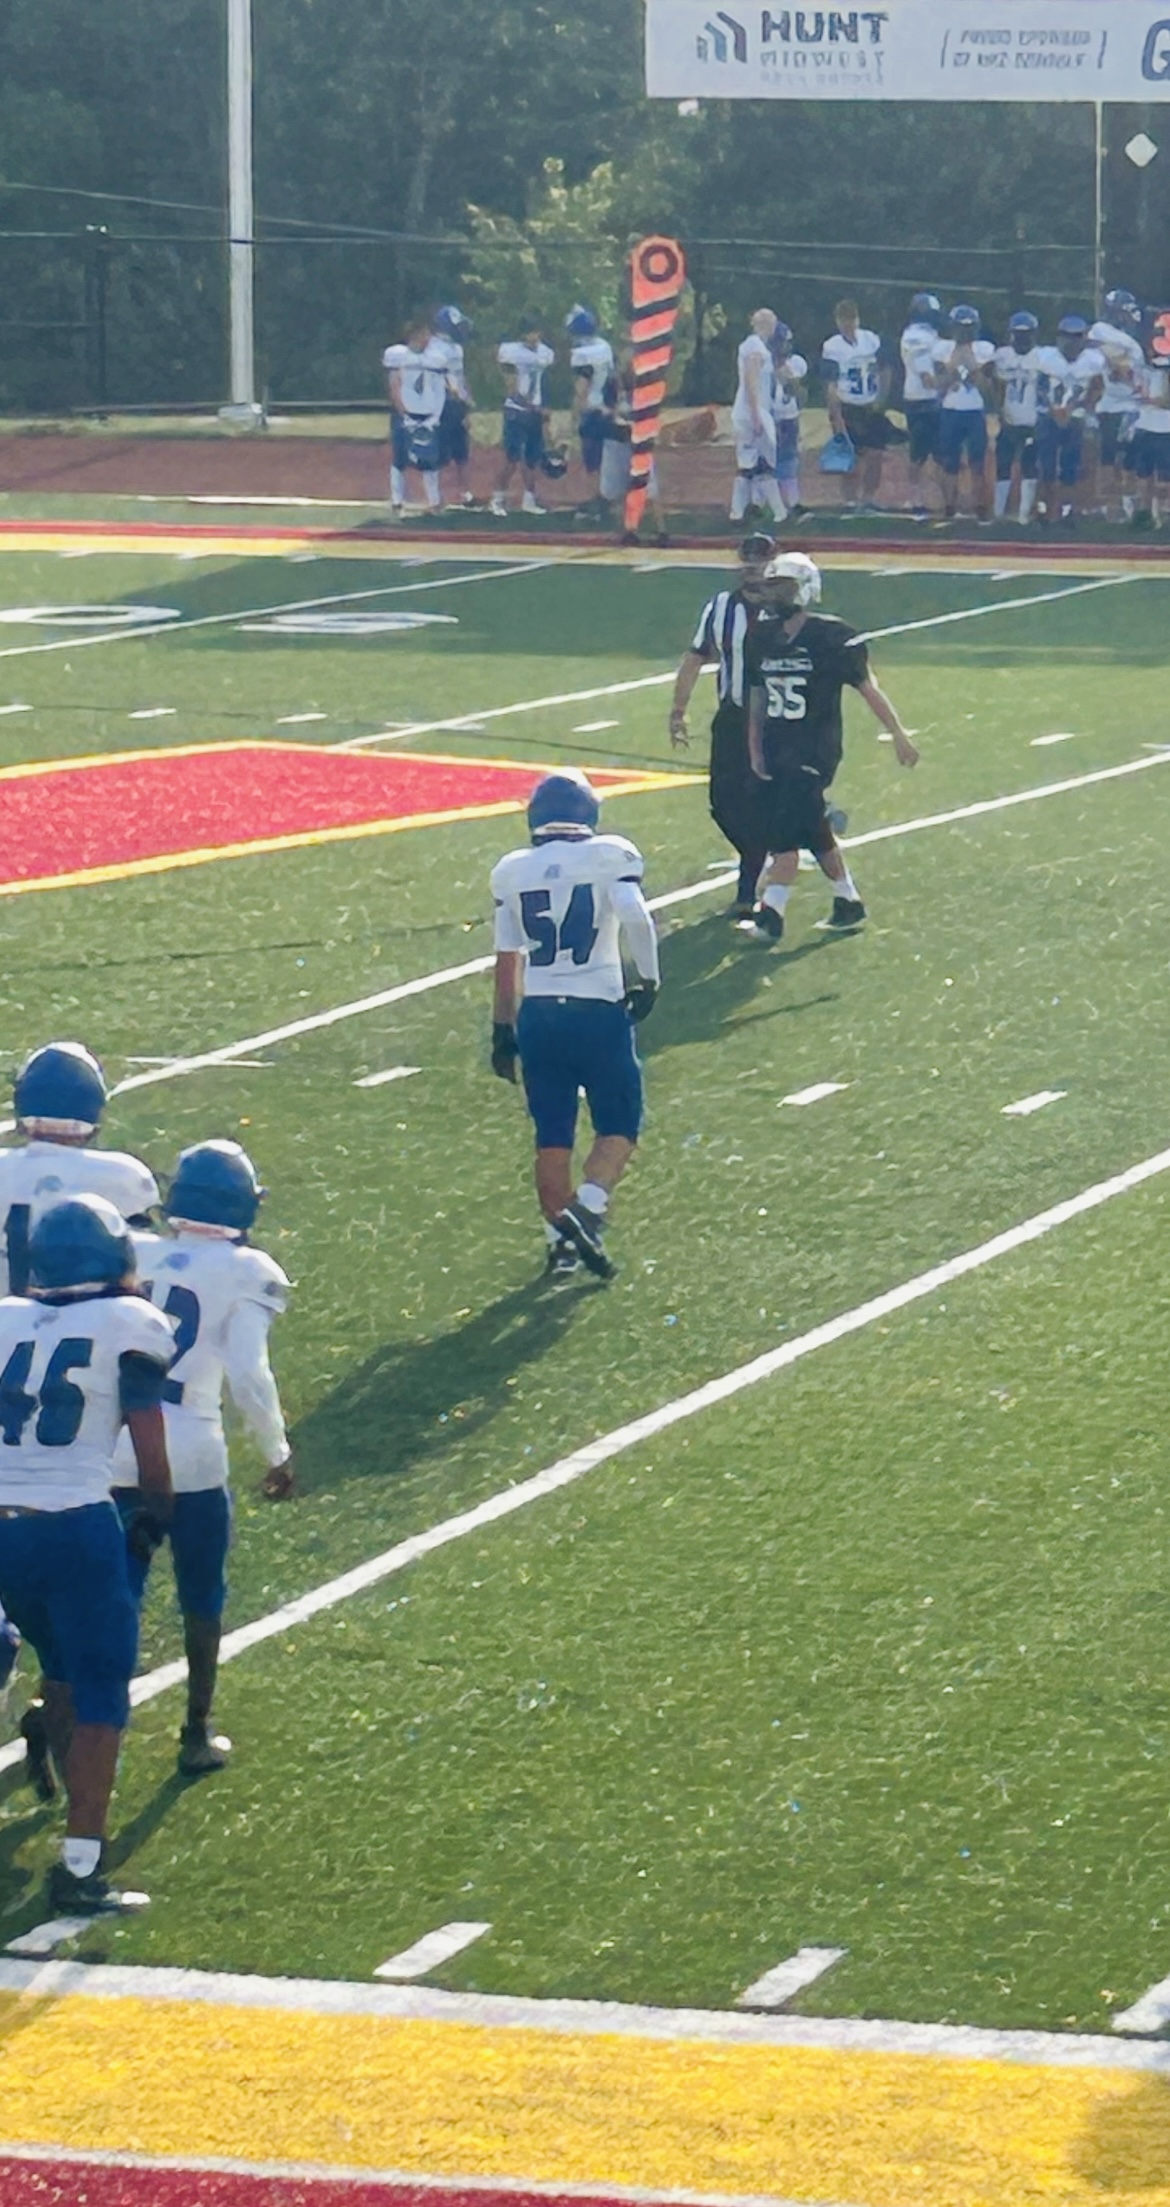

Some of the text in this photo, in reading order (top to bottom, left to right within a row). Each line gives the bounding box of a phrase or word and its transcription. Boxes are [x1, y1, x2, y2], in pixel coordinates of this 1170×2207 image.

[761, 10, 888, 43] HUNT
[765, 674, 806, 719] 55
[519, 883, 599, 967] 54
[142, 1281, 200, 1405] 2
[0, 1337, 94, 1446] 46
